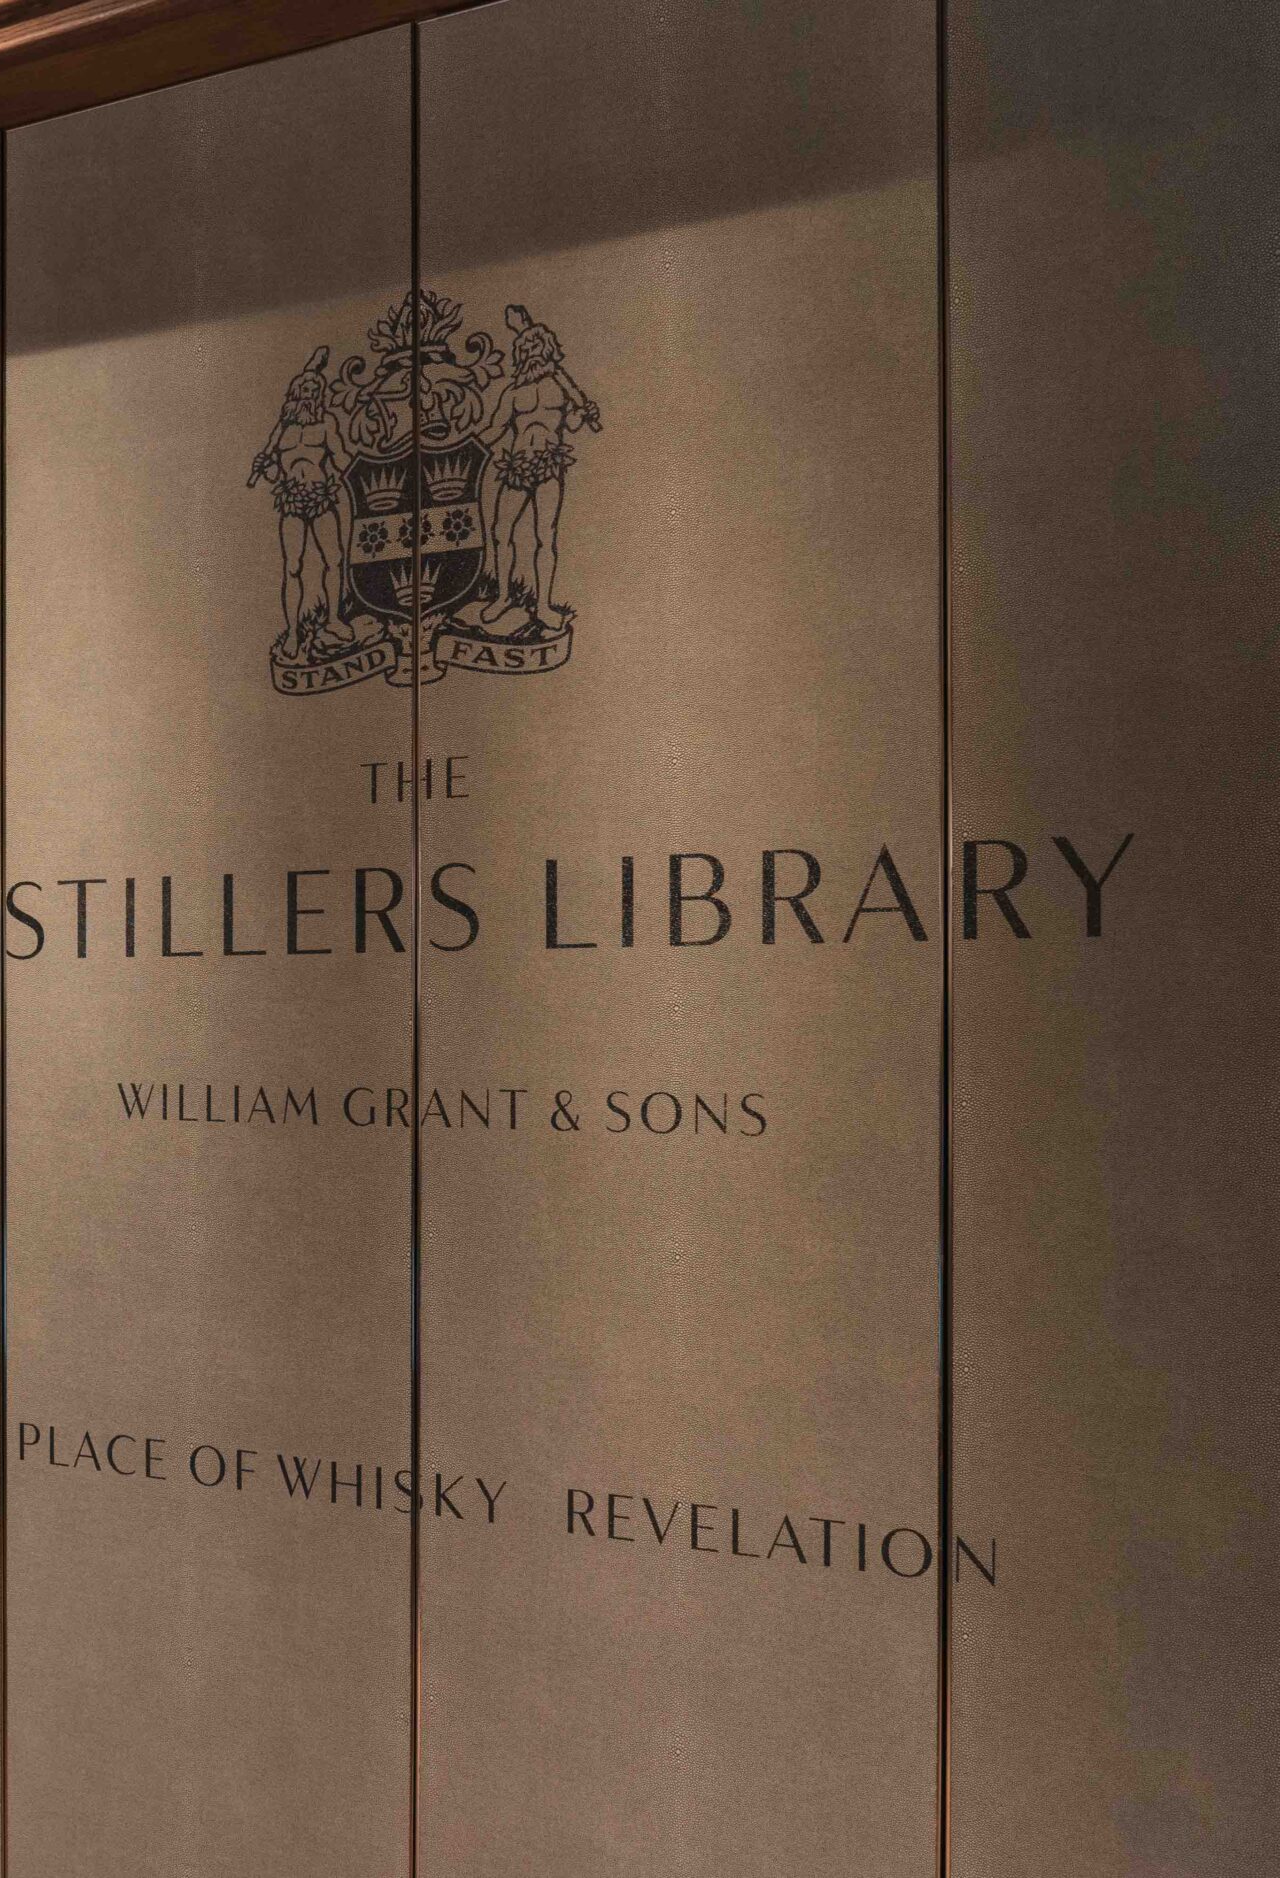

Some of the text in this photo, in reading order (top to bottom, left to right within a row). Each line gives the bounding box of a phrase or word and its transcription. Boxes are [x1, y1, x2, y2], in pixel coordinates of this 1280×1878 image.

[281, 640, 558, 690] STAND FAST
[359, 755, 470, 804] THE
[545, 832, 1135, 950] LIBRARY
[117, 1082, 768, 1138] WILLIAM GRANT & SONS
[19, 1422, 167, 1480] PLACE
[189, 1444, 259, 1490] OF
[276, 1453, 508, 1523] WHISKY
[566, 1488, 997, 1588] REVELATION
